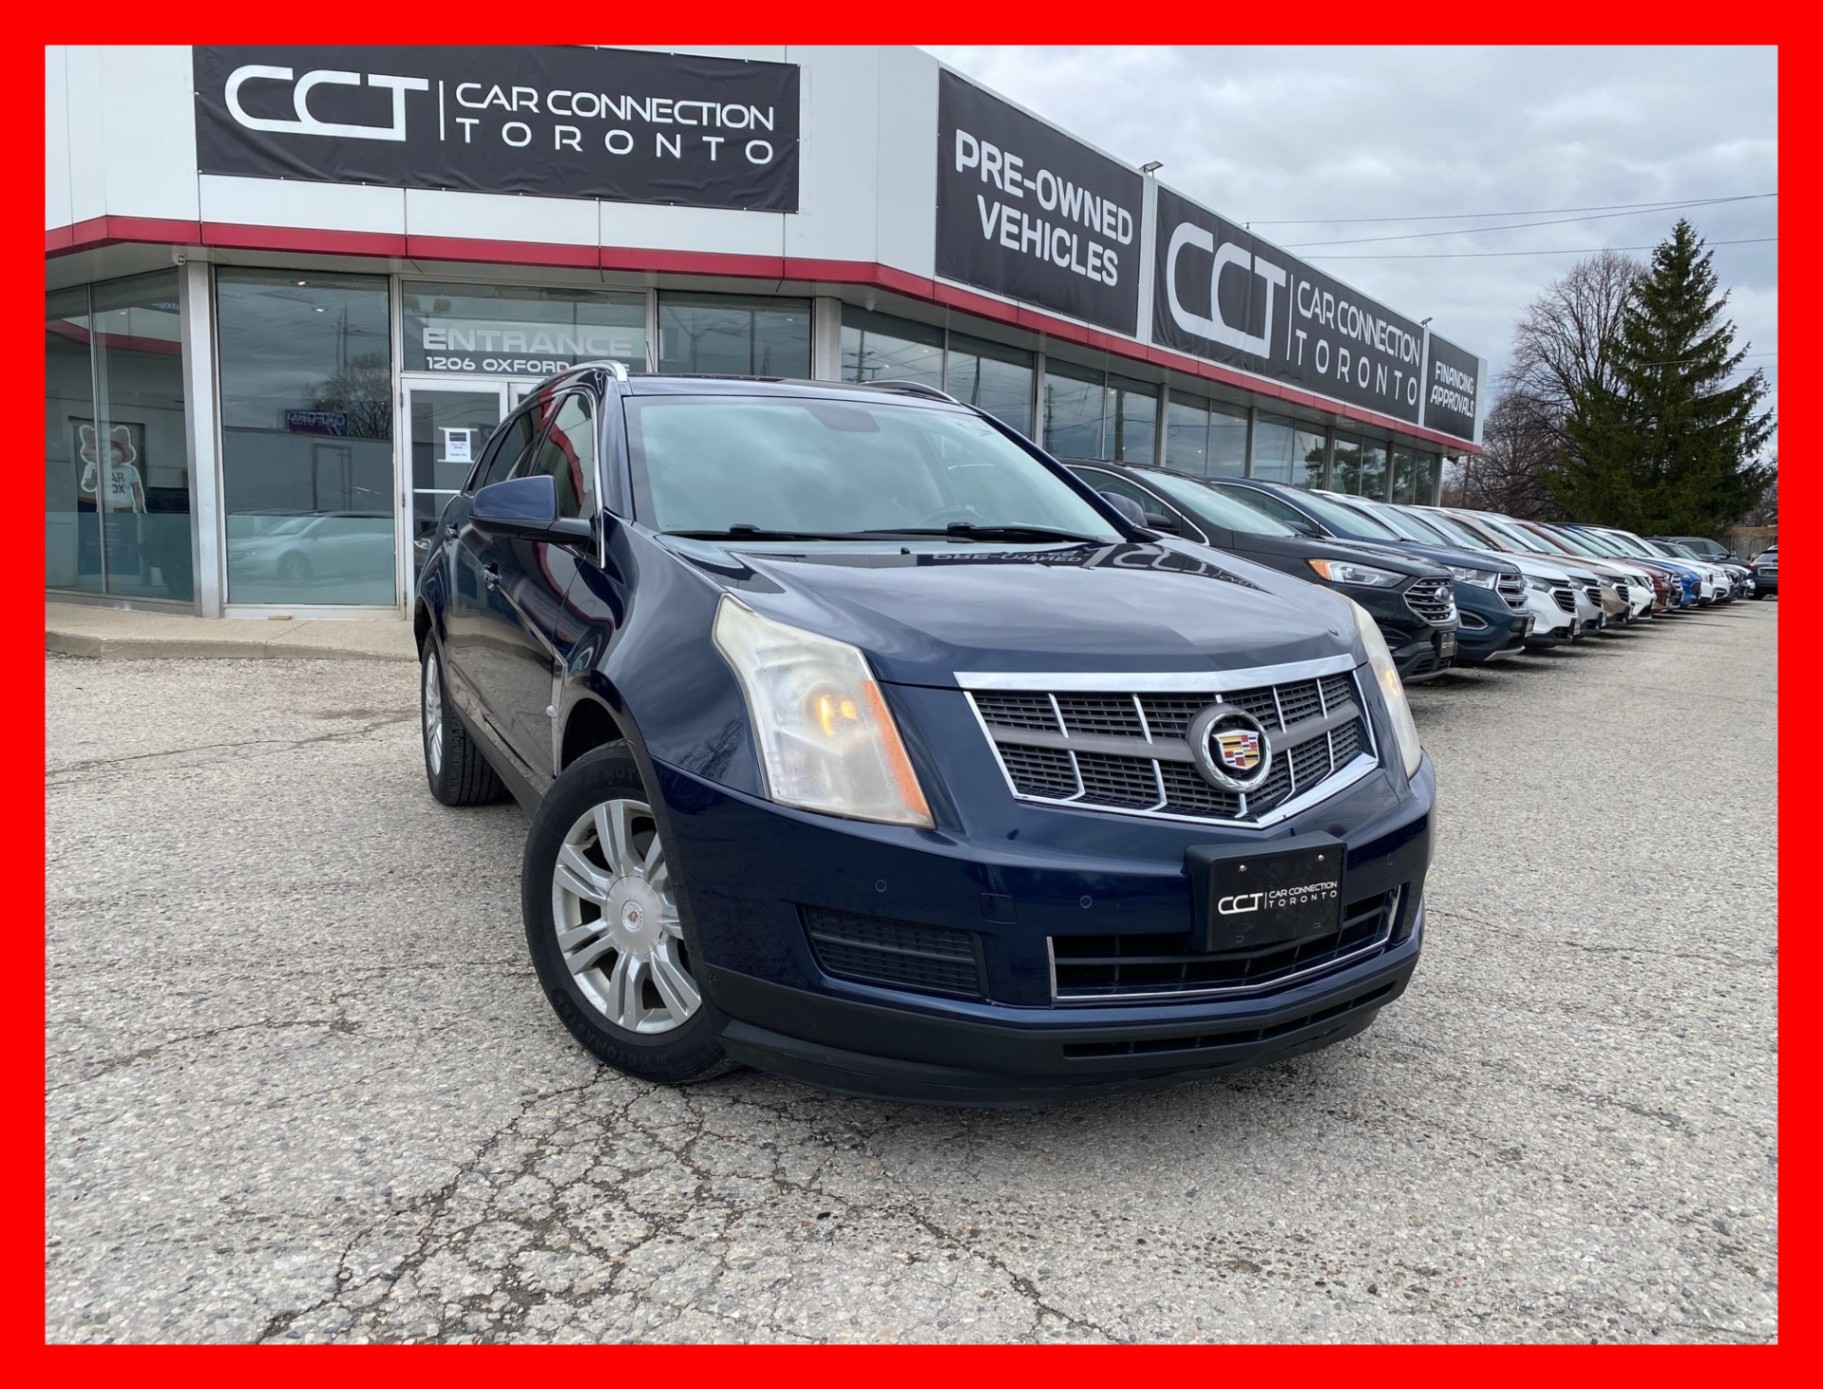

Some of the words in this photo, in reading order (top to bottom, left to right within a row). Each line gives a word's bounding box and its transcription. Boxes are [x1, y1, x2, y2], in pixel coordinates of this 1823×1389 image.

[224, 64, 429, 142] CCT
[456, 82, 540, 113] CAR
[547, 93, 774, 132] CONNECTION
[456, 117, 774, 165] TORONTO
[955, 129, 1133, 246] PRE-OWNED
[976, 194, 1119, 287] VEHICLES
[1166, 222, 1286, 360] CCT
[423, 327, 632, 357] ENTRANCE
[1298, 280, 1335, 329] CAR
[1338, 302, 1420, 368] CONNECTION
[426, 356, 476, 371] 1206
[482, 358, 570, 374] OXFORD
[1296, 328, 1418, 405] TORONTO
[1435, 361, 1474, 395] FINANCING
[1430, 384, 1474, 418] APPROVALS
[1218, 893, 1263, 915] CCT
[1268, 889, 1288, 899] CAR
[1288, 881, 1338, 896] CONNECTION
[1268, 890, 1338, 909] TORONTO
